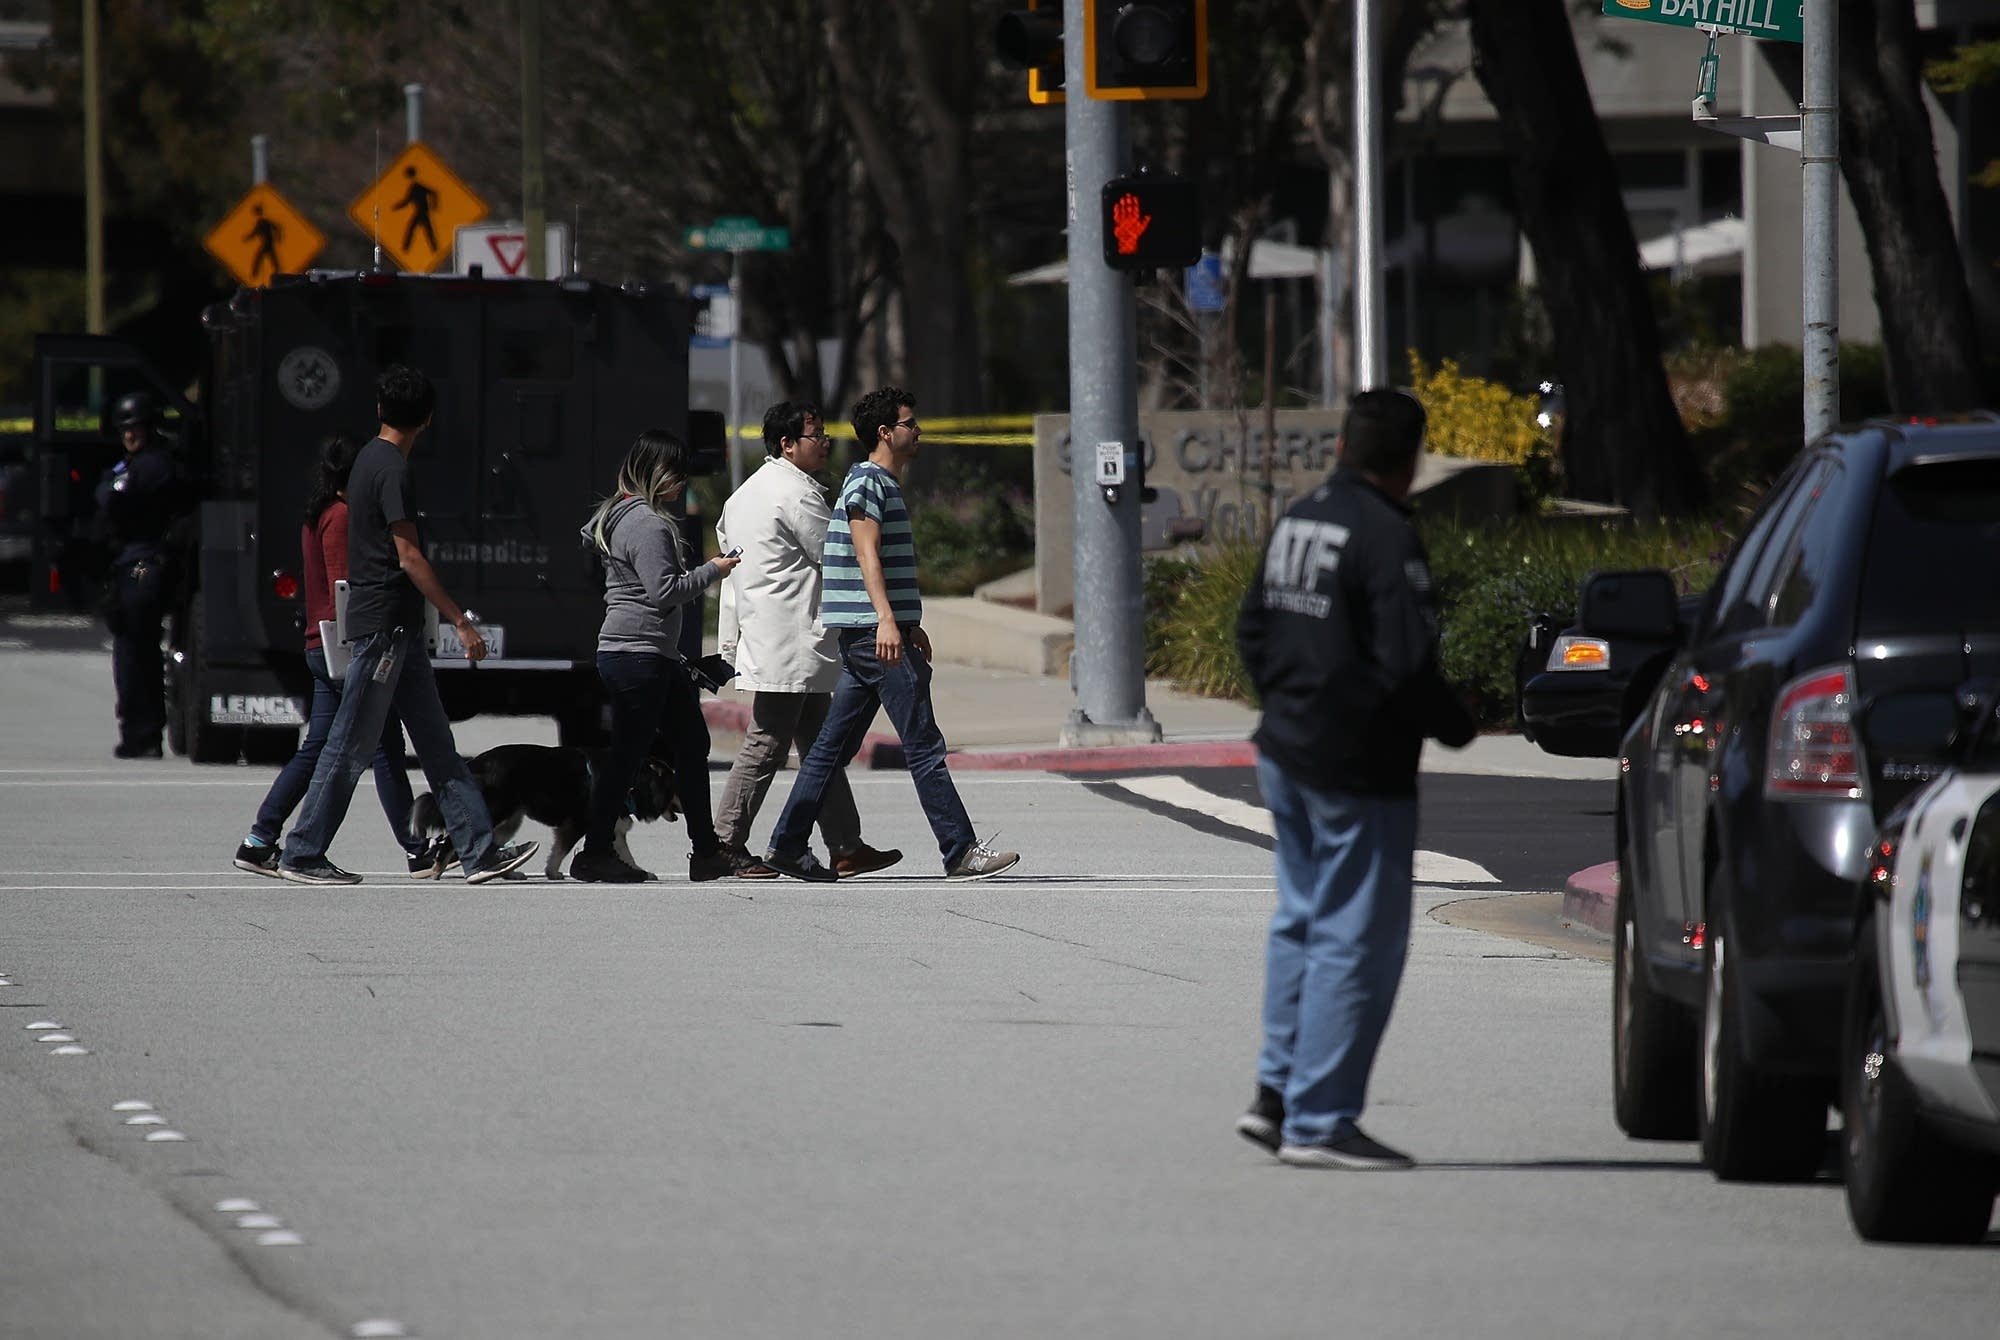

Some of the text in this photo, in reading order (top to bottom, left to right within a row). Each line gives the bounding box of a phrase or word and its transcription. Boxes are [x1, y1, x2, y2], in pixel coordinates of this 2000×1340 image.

[1177, 428, 1338, 473] CHERR
[427, 539, 549, 564] ramedics
[1264, 517, 1350, 592] ATF
